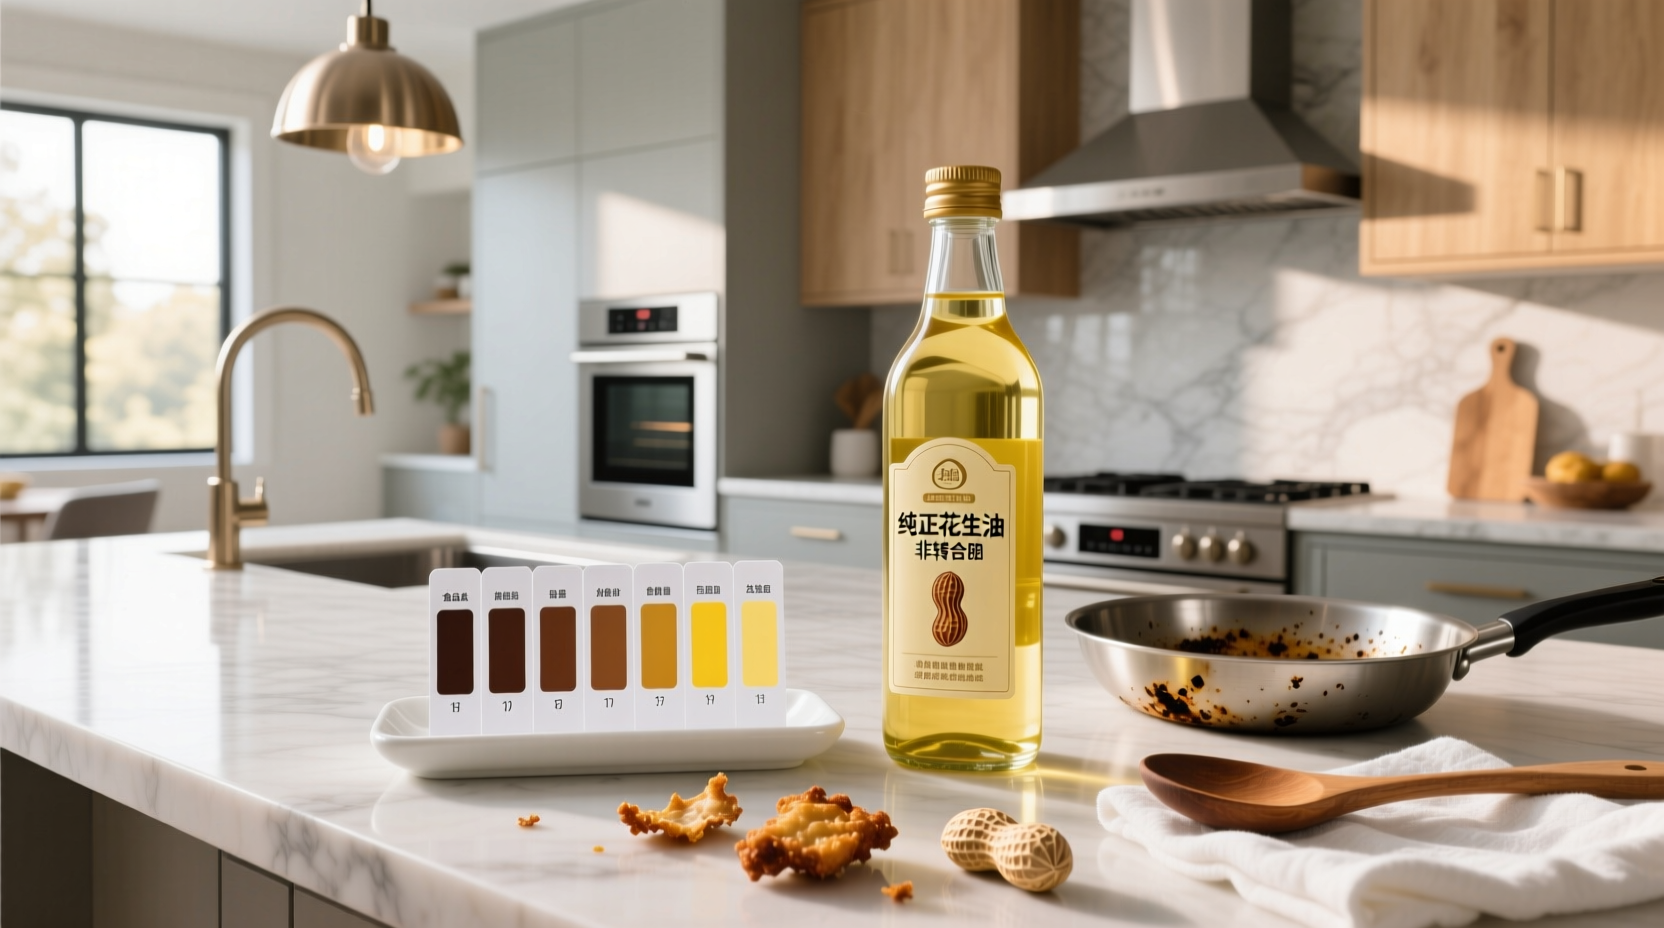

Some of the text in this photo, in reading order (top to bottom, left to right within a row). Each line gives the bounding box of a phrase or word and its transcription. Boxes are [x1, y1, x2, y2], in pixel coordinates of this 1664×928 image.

[898, 511, 1005, 538] 纯正花生油
